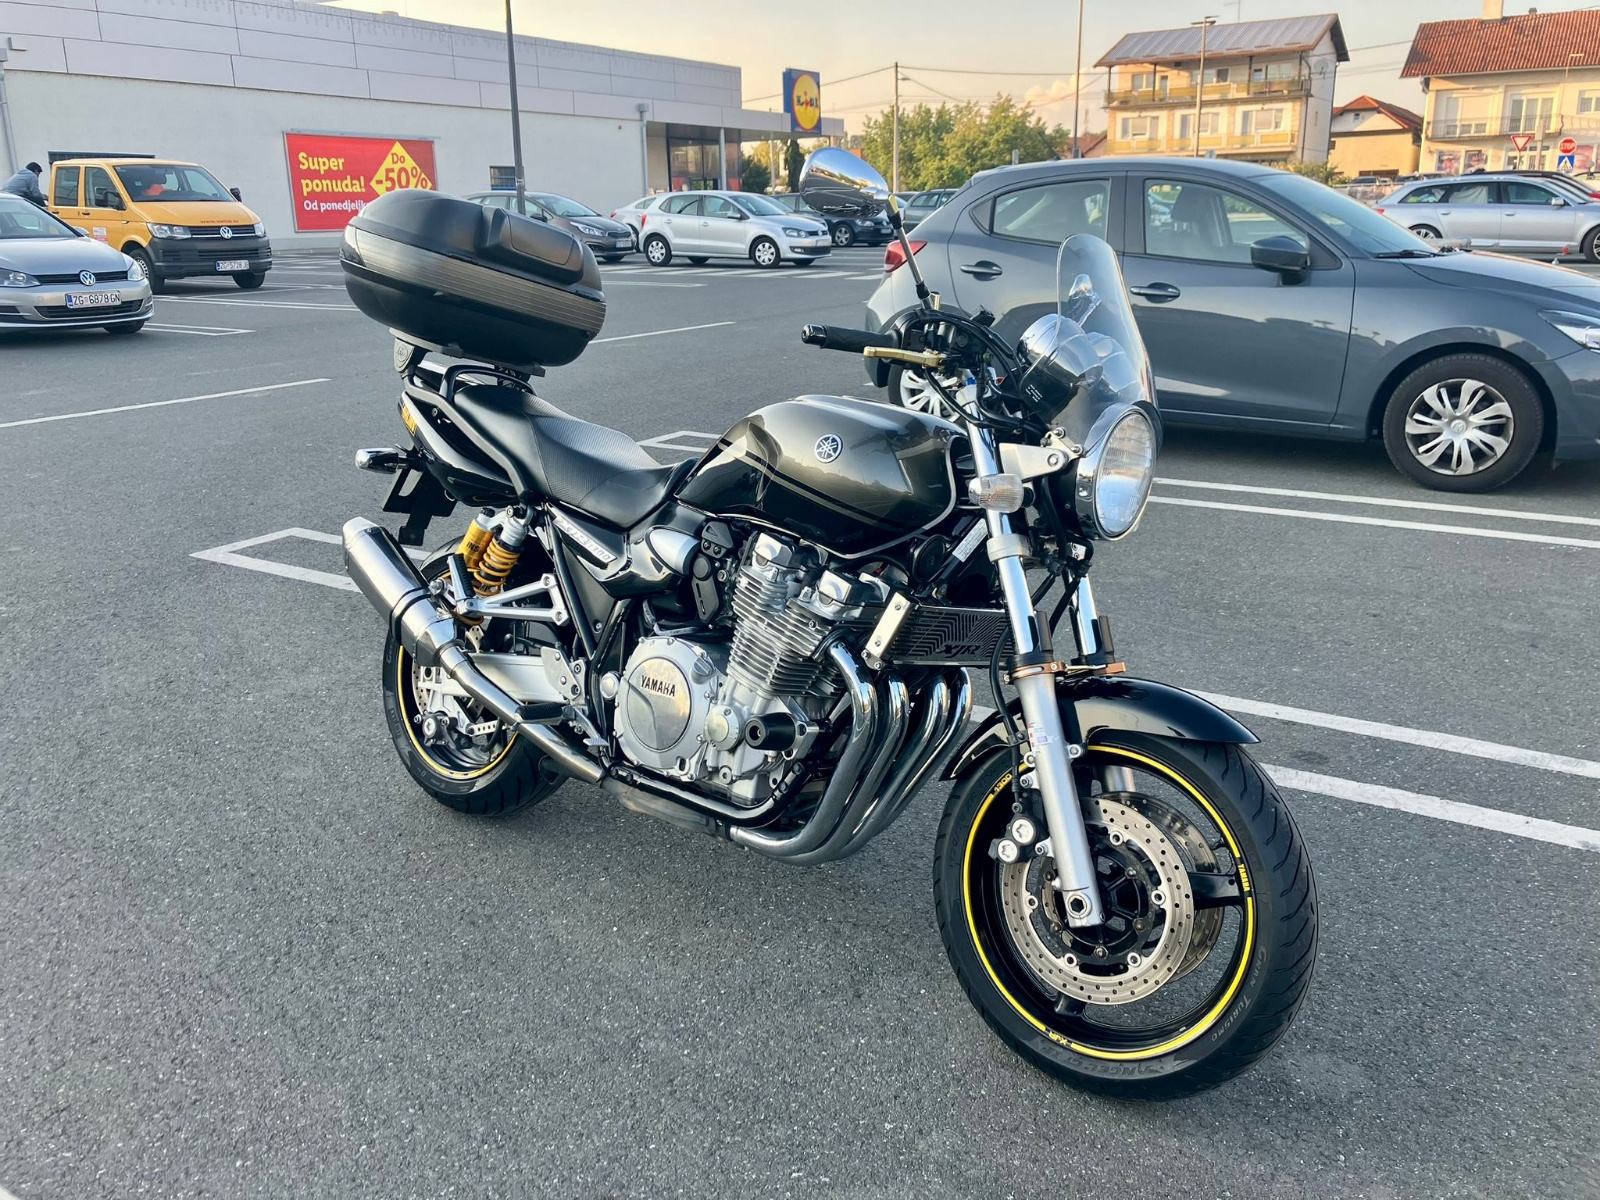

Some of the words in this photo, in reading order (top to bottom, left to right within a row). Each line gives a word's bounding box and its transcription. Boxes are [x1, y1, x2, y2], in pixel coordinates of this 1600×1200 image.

[298, 151, 345, 175] Super
[391, 152, 406, 165] Do
[300, 175, 366, 196] ponuda!
[375, 166, 428, 192] -50%
[303, 200, 319, 211] Od
[319, 199, 368, 213] ponedjeljk
[73, 295, 84, 305] ZG
[641, 674, 676, 697] YAMAHA
[993, 773, 1013, 798] 1300
[1237, 863, 1251, 892] YAMAHA
